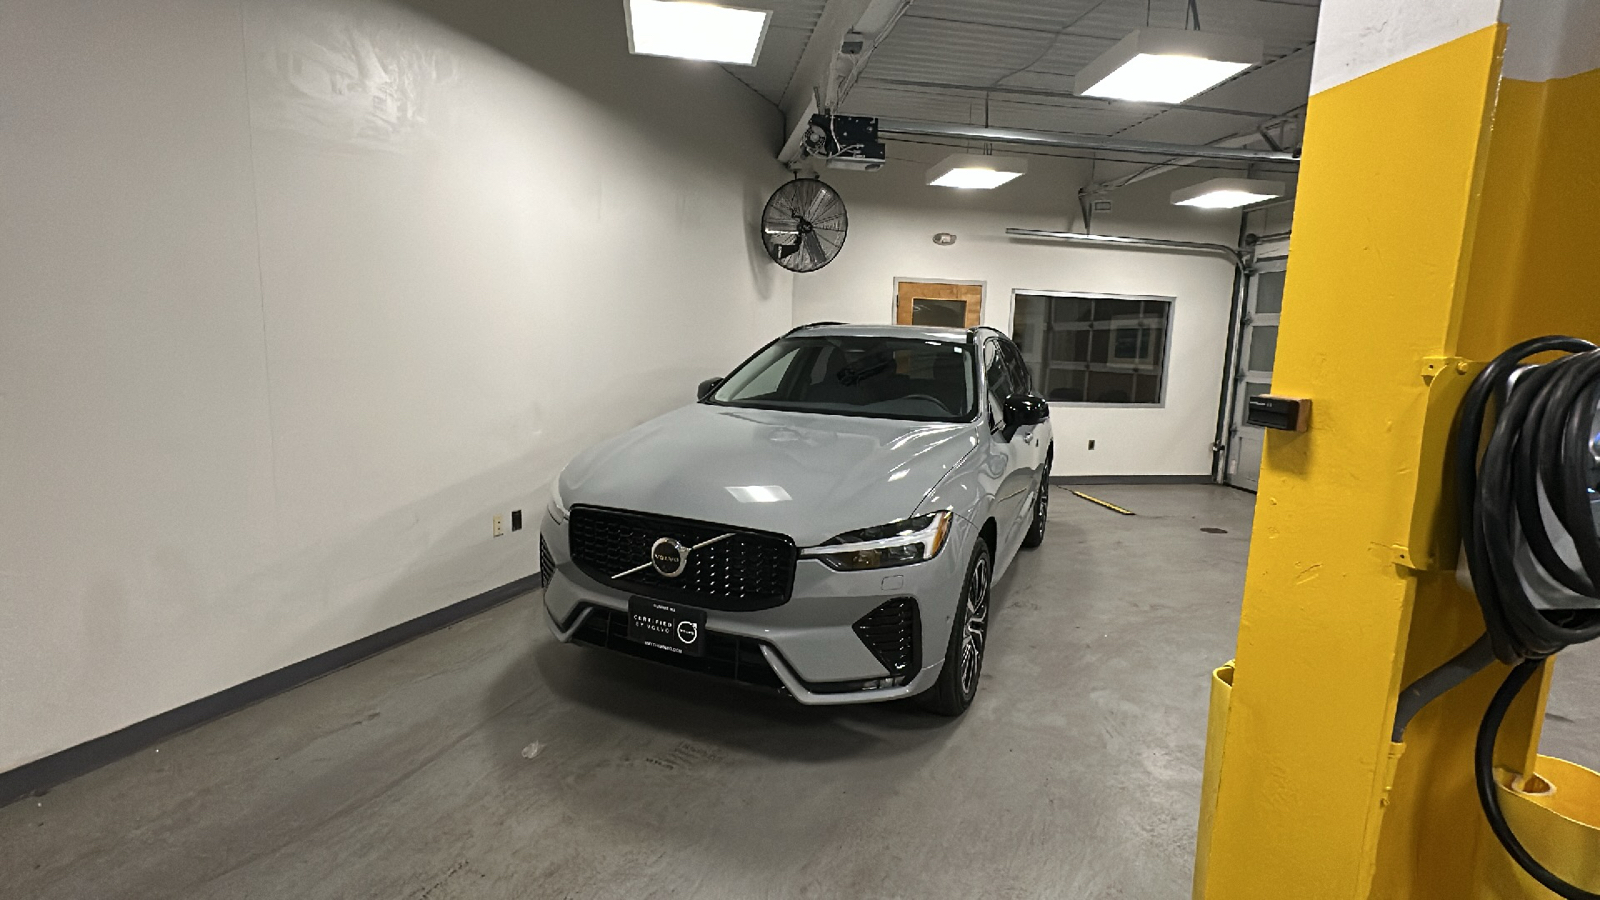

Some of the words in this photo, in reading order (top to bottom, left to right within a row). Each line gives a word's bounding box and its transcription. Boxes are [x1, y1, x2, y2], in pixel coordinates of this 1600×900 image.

[654, 553, 679, 562] VOLVO
[633, 614, 673, 628] CERTIFIED
[647, 624, 670, 634] VOLVO
